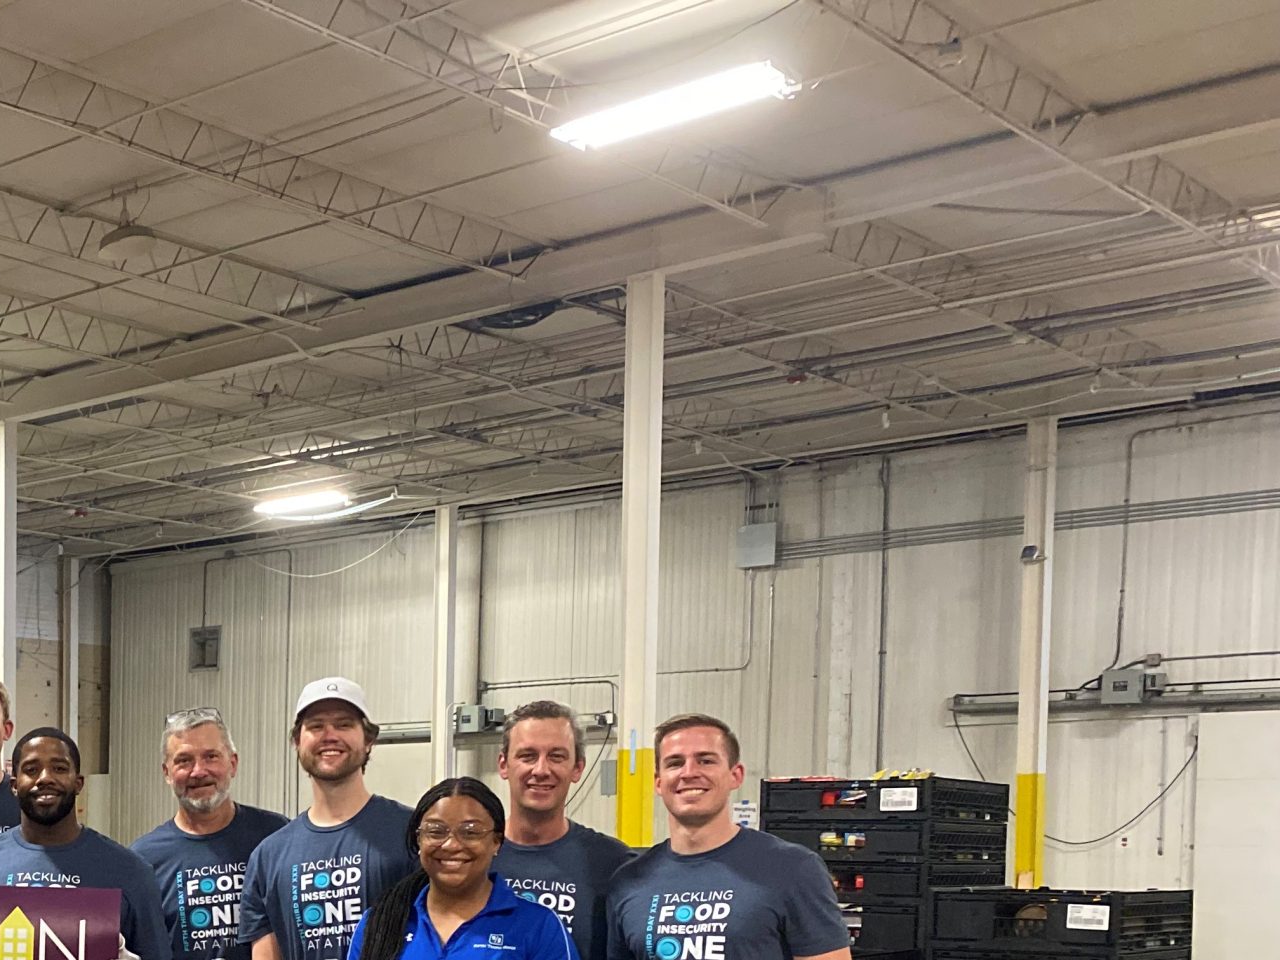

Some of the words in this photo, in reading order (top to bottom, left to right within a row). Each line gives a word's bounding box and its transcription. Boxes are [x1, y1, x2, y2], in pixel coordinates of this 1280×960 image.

[185, 862, 247, 878] TACKLING
[301, 854, 362, 872] TACKLING
[16, 871, 81, 884] TACKLING
[300, 867, 362, 890] FOOD
[504, 878, 577, 893] TACKLING
[188, 892, 243, 906] INSECURIT
[301, 886, 360, 902] INSECURITY
[663, 889, 734, 904] TACKLING
[303, 898, 362, 925] ONE
[658, 902, 731, 922] FOOD
[305, 924, 357, 938] COMMUNIT
[646, 915, 655, 932] DAY
[657, 922, 728, 935] INSECURITY
[193, 940, 207, 951] AT
[212, 939, 221, 949] A
[308, 938, 320, 951] AT
[324, 938, 333, 949] A
[656, 935, 726, 960] ONE
